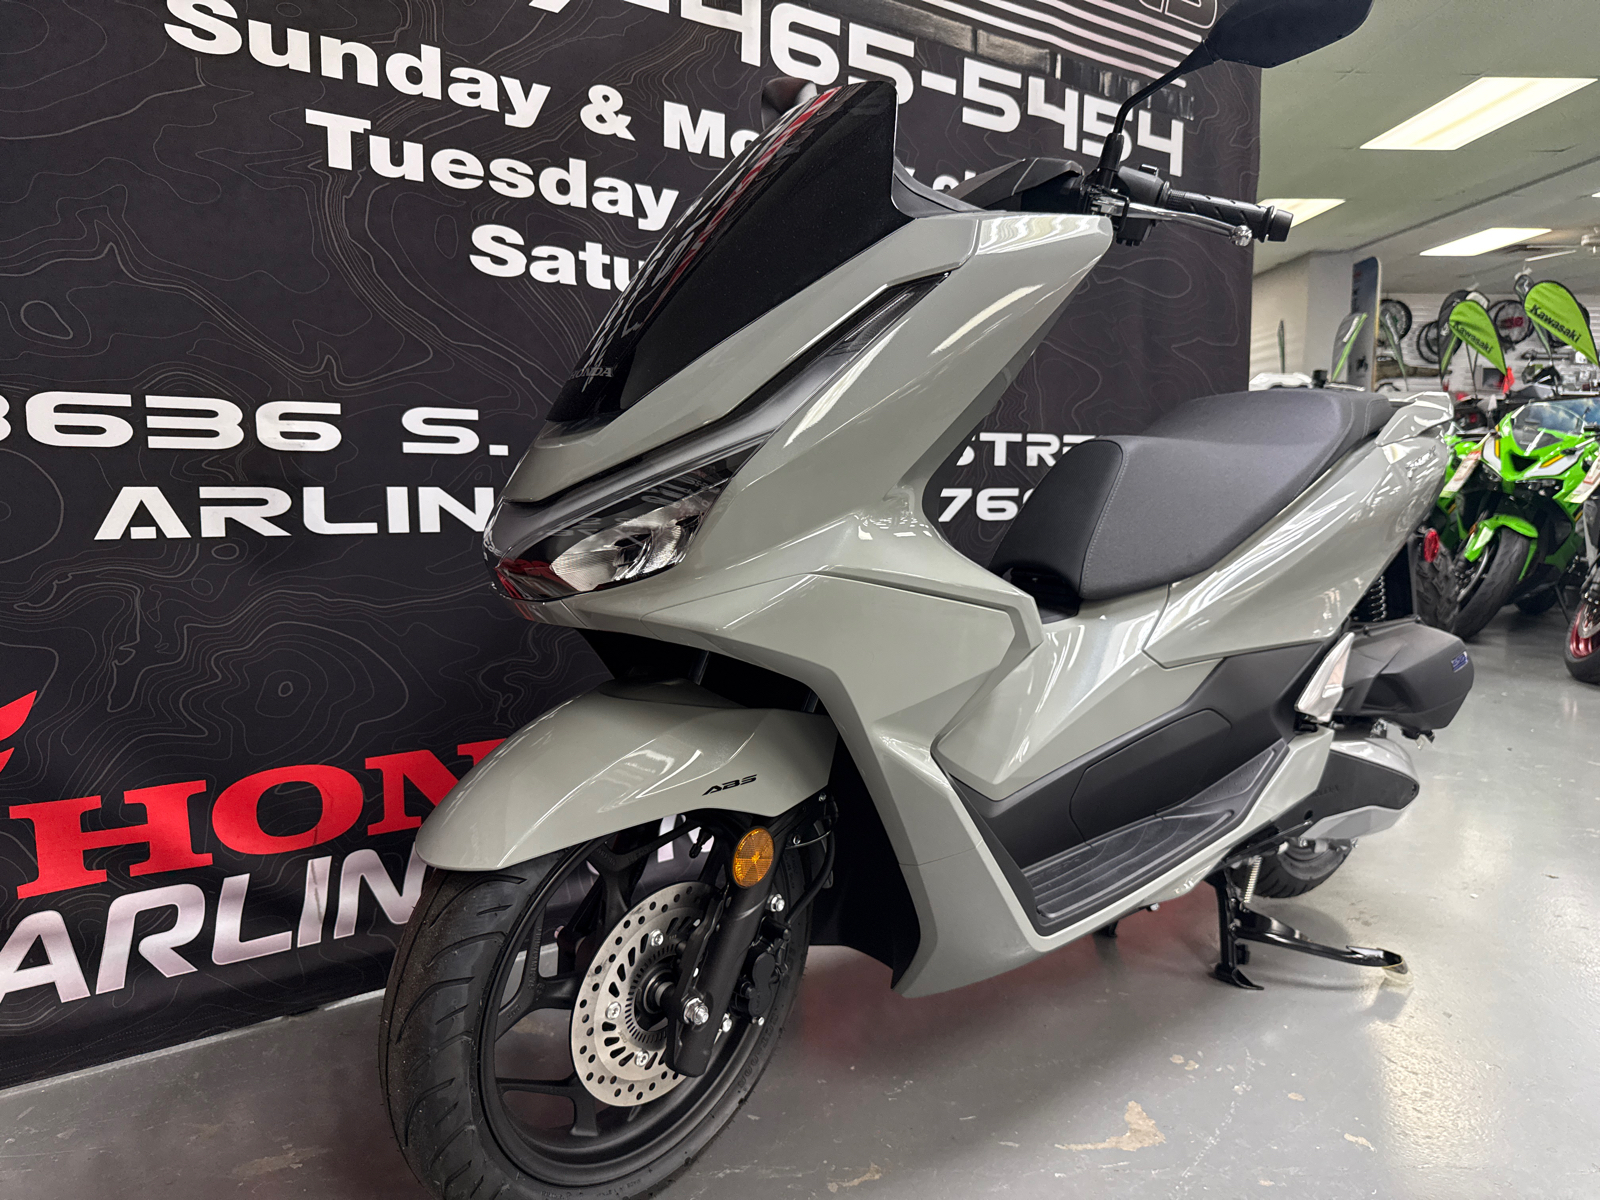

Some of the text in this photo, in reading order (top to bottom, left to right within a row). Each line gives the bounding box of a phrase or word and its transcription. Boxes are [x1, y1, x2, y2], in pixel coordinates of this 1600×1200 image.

[164, 0, 551, 128] Sunday
[580, 84, 636, 142] &
[305, 108, 680, 231] Tuesday
[1454, 322, 1494, 353] Kawasaki
[1529, 303, 1582, 344] Kawasaki
[0, 391, 343, 452] 636
[401, 406, 510, 456] S.
[94, 486, 1034, 540] ARLIN 76
[702, 774, 758, 796] ABS
